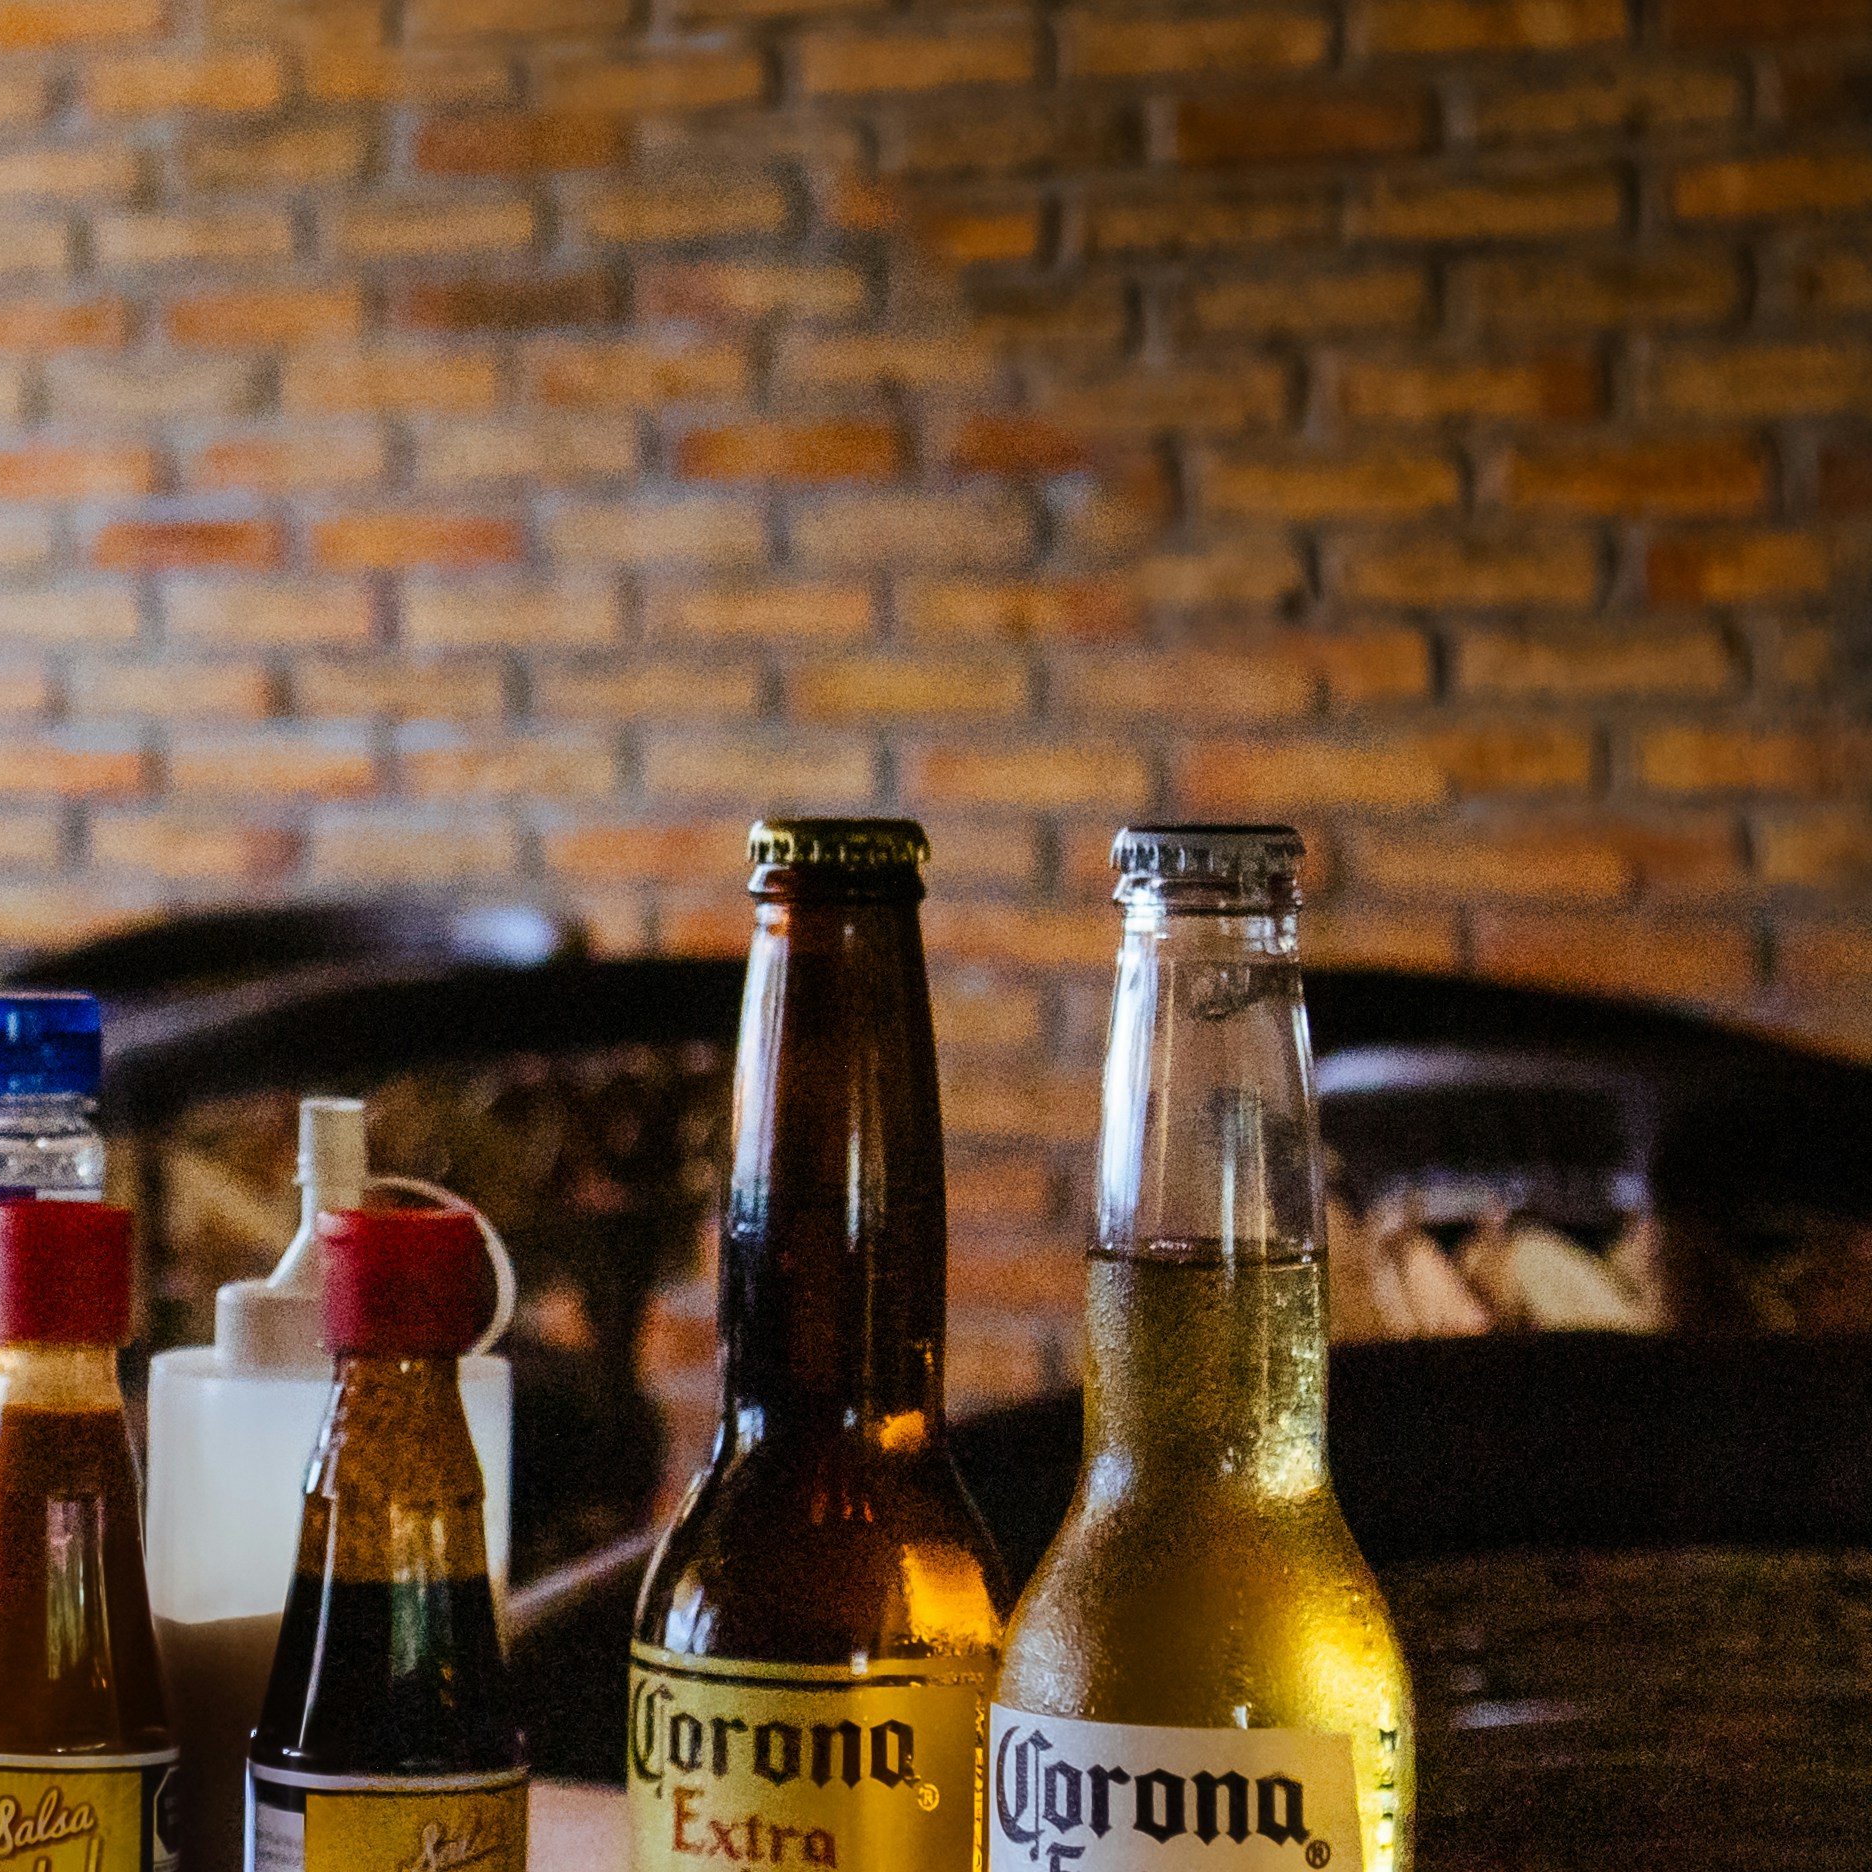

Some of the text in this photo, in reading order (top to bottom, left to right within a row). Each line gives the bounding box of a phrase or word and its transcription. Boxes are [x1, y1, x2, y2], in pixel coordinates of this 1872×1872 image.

[631, 1679, 920, 1799] Corona
[997, 1726, 1309, 1861] Corona
[673, 1786, 837, 1868] Extra
